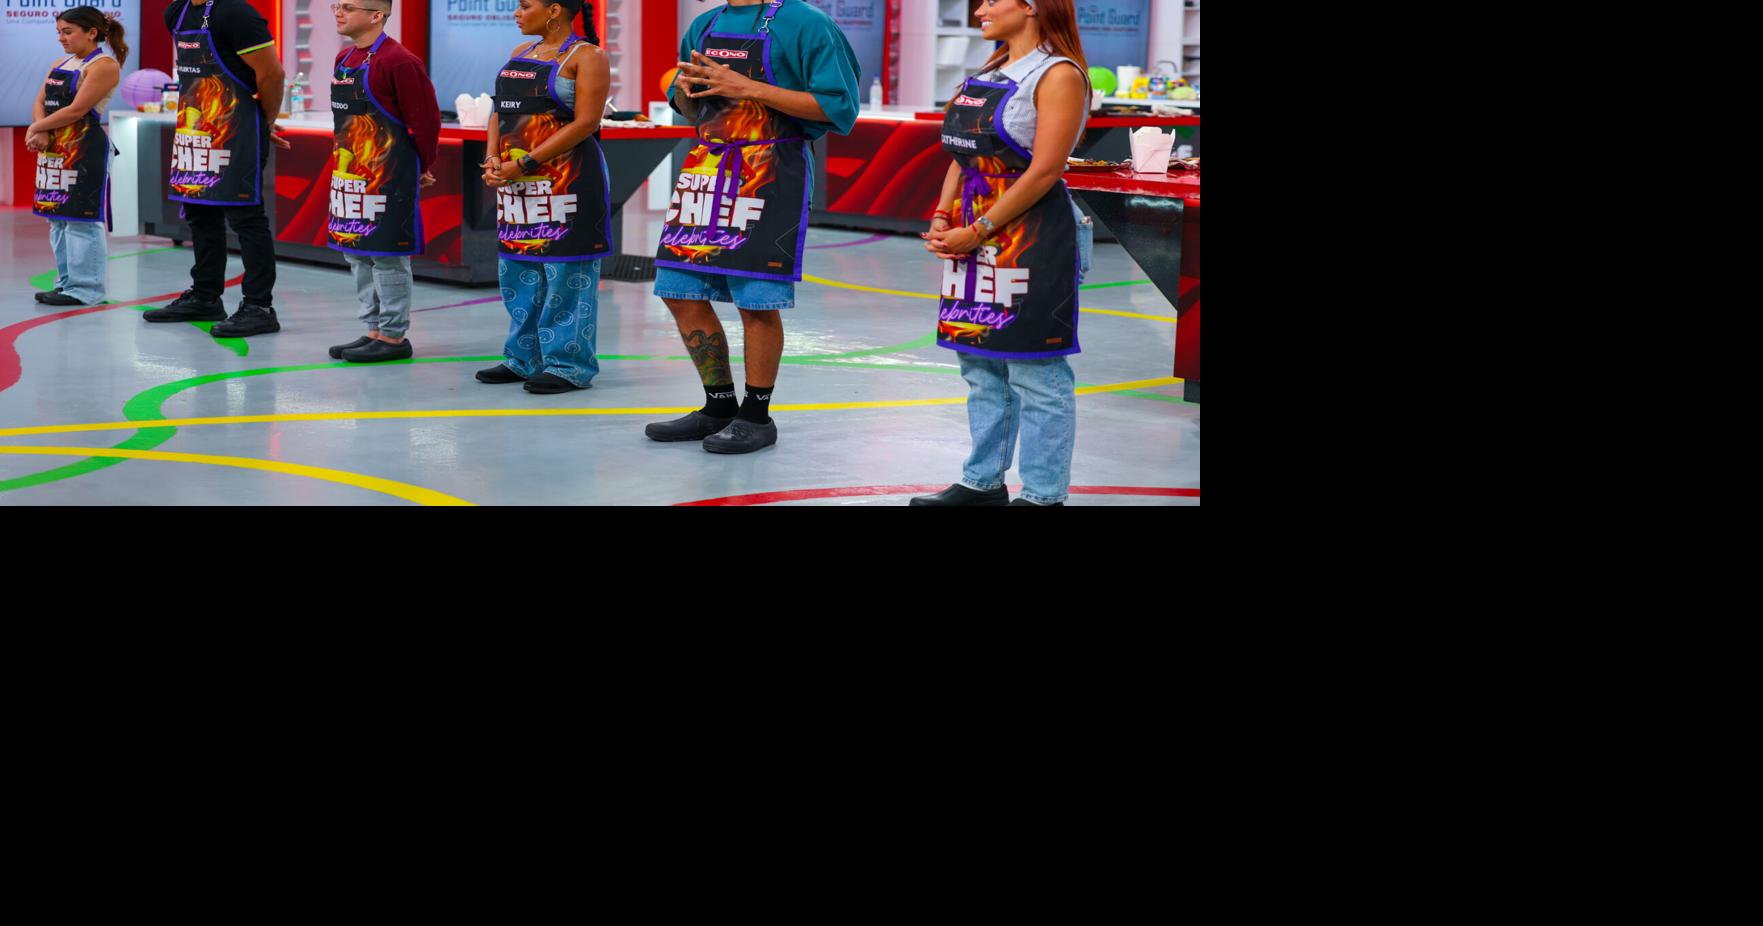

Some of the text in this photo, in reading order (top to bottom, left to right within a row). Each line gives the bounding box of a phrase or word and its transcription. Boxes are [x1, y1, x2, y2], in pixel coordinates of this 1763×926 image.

[500, 100, 521, 109] KEIRY
[36, 166, 79, 192] HEF
[329, 189, 387, 221] HEF
